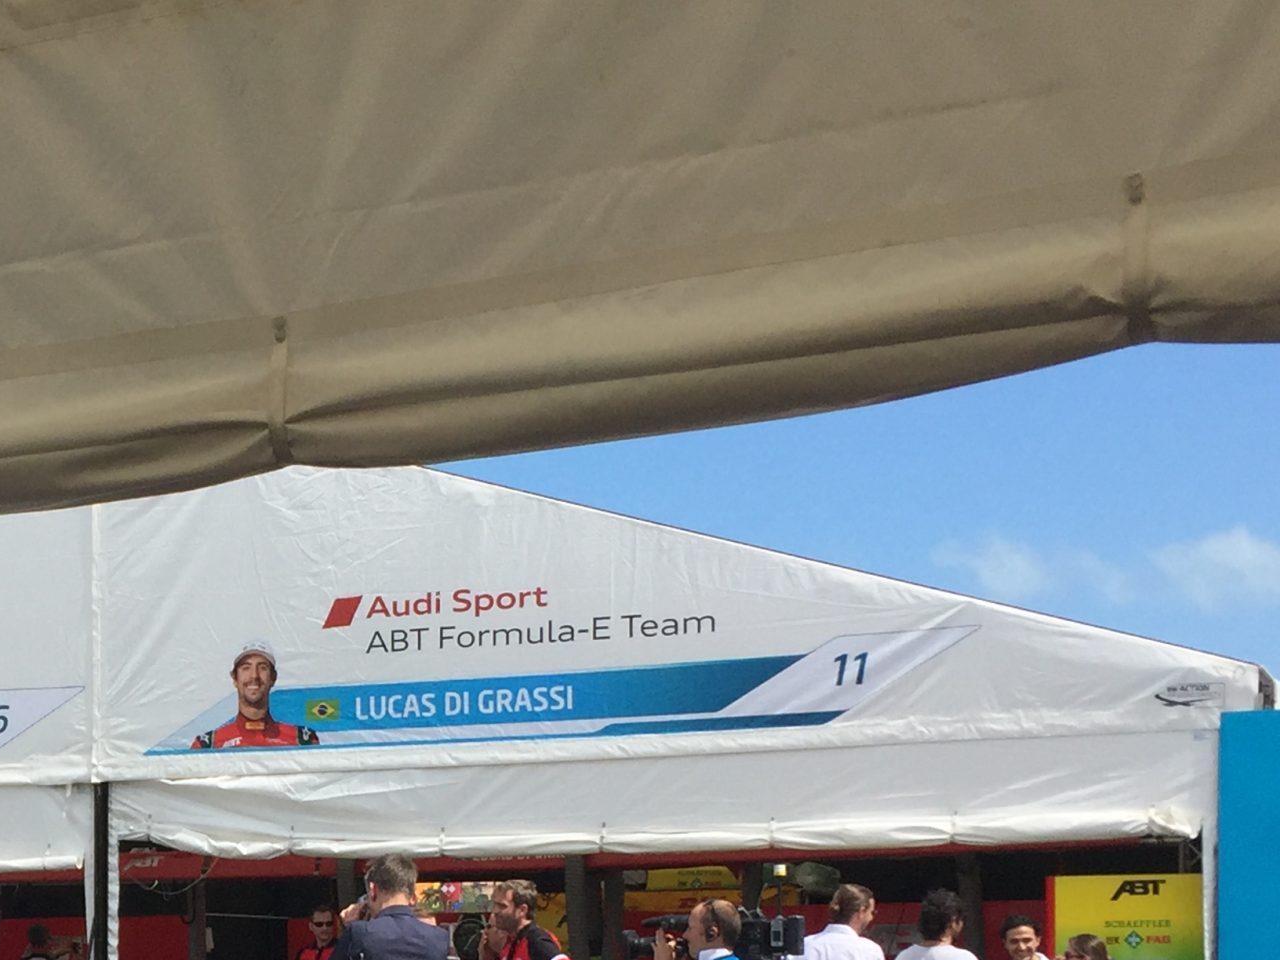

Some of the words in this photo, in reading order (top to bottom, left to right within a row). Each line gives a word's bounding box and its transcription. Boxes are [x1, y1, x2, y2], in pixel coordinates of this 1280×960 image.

[366, 591, 441, 619] Audi
[452, 586, 548, 617] Sport
[365, 628, 429, 654] ABT
[438, 616, 611, 649] Formula-E
[620, 612, 716, 638] Team
[832, 651, 869, 686] 11
[355, 690, 437, 721] LUCAS
[444, 689, 471, 717] DI
[477, 684, 574, 715] GRASSI
[1110, 879, 1166, 901] ABT
